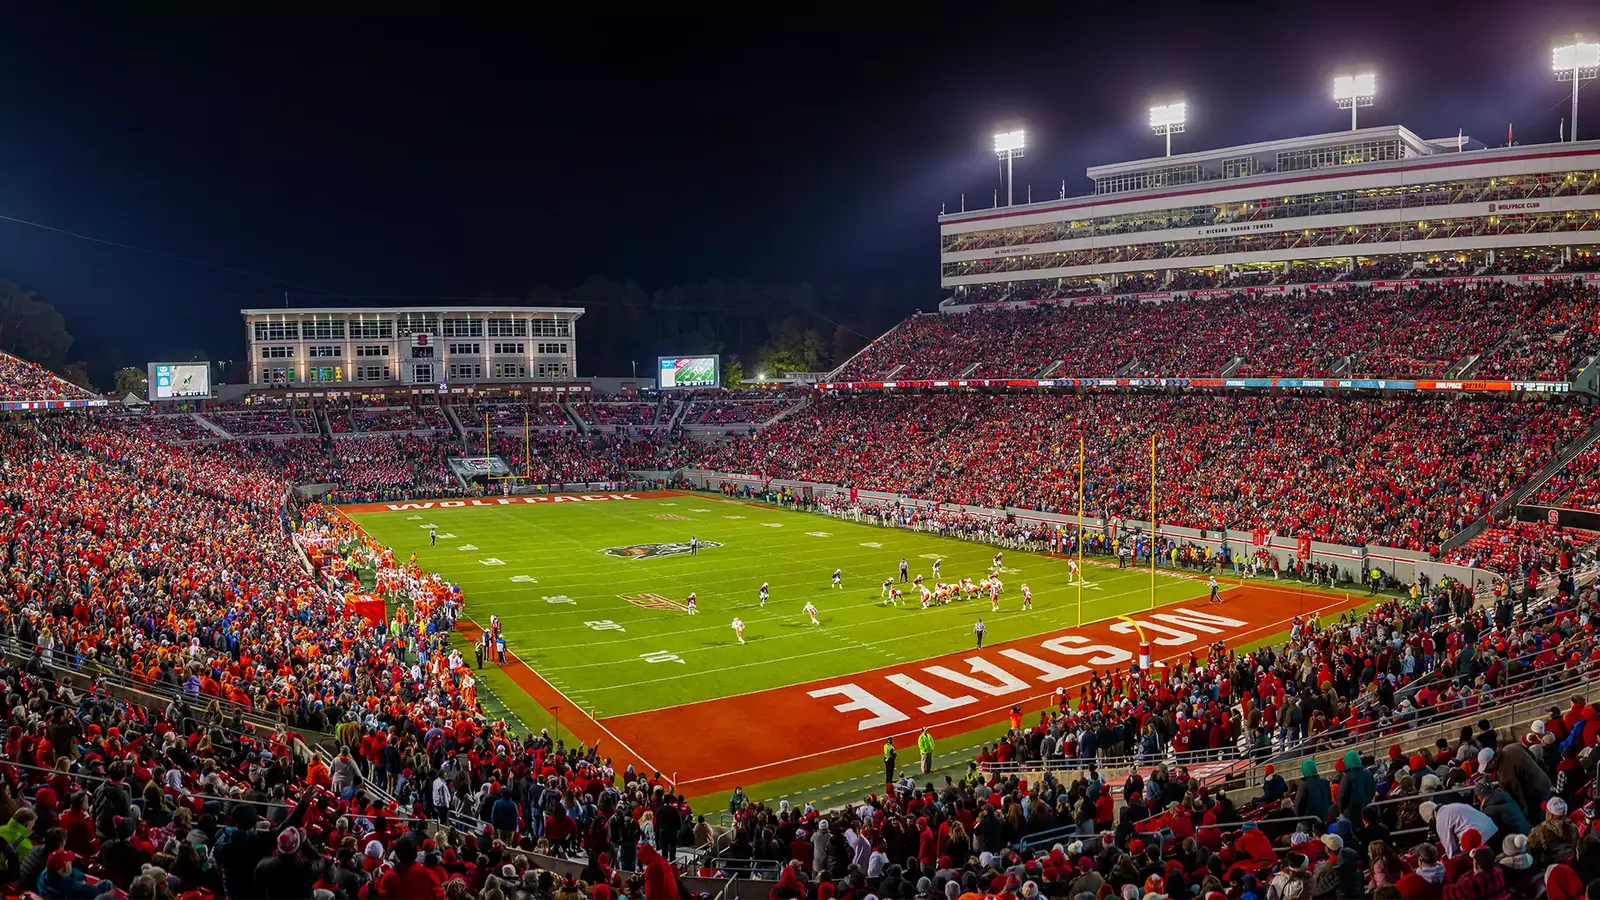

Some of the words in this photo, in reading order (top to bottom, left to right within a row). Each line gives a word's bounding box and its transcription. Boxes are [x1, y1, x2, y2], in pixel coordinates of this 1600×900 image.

[386, 494, 640, 511] WOLFPACK
[1109, 607, 1248, 646] NC
[639, 649, 680, 663] 10
[806, 635, 1133, 731] STATE
